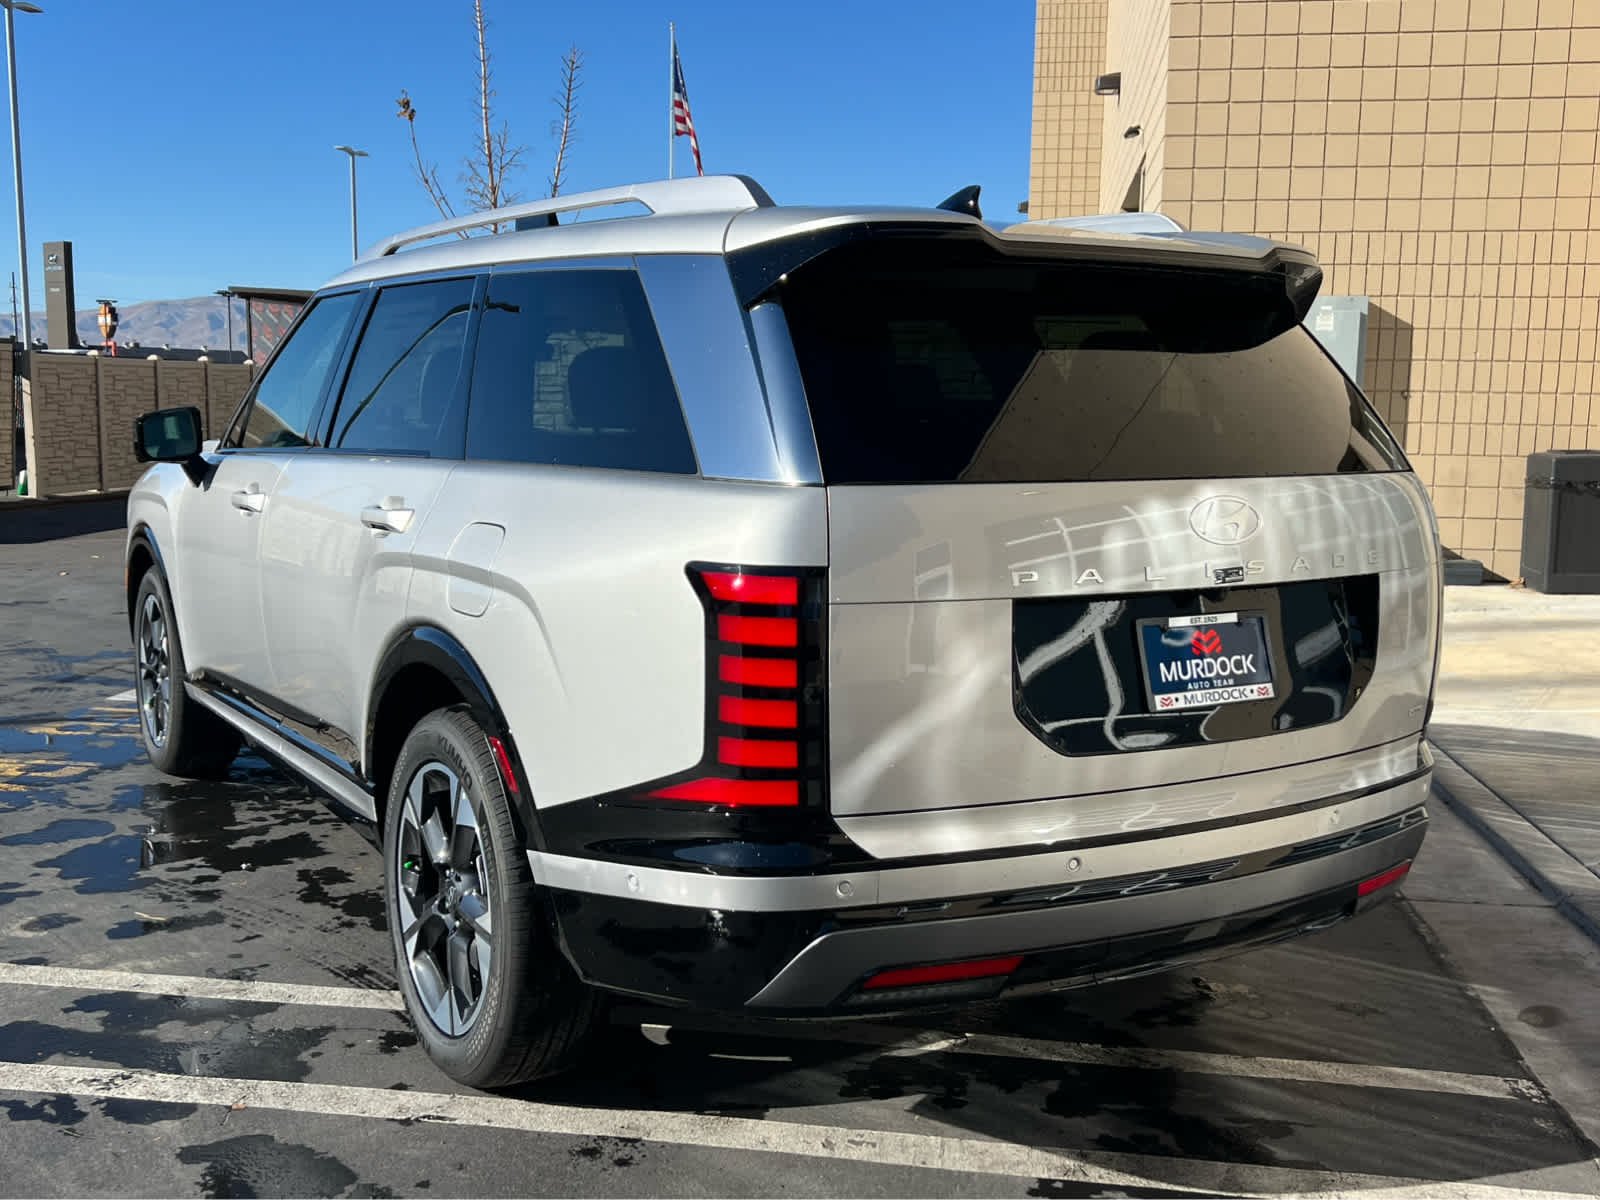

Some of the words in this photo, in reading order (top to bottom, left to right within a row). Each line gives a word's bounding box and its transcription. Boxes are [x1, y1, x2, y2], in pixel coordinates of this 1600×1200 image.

[1011, 550, 1384, 586] PALISADE
[1159, 654, 1256, 683] MURDOCK
[1187, 681, 1210, 690] AUTO
[1213, 678, 1235, 687] TEAM
[1183, 687, 1249, 705] MURDOCK
